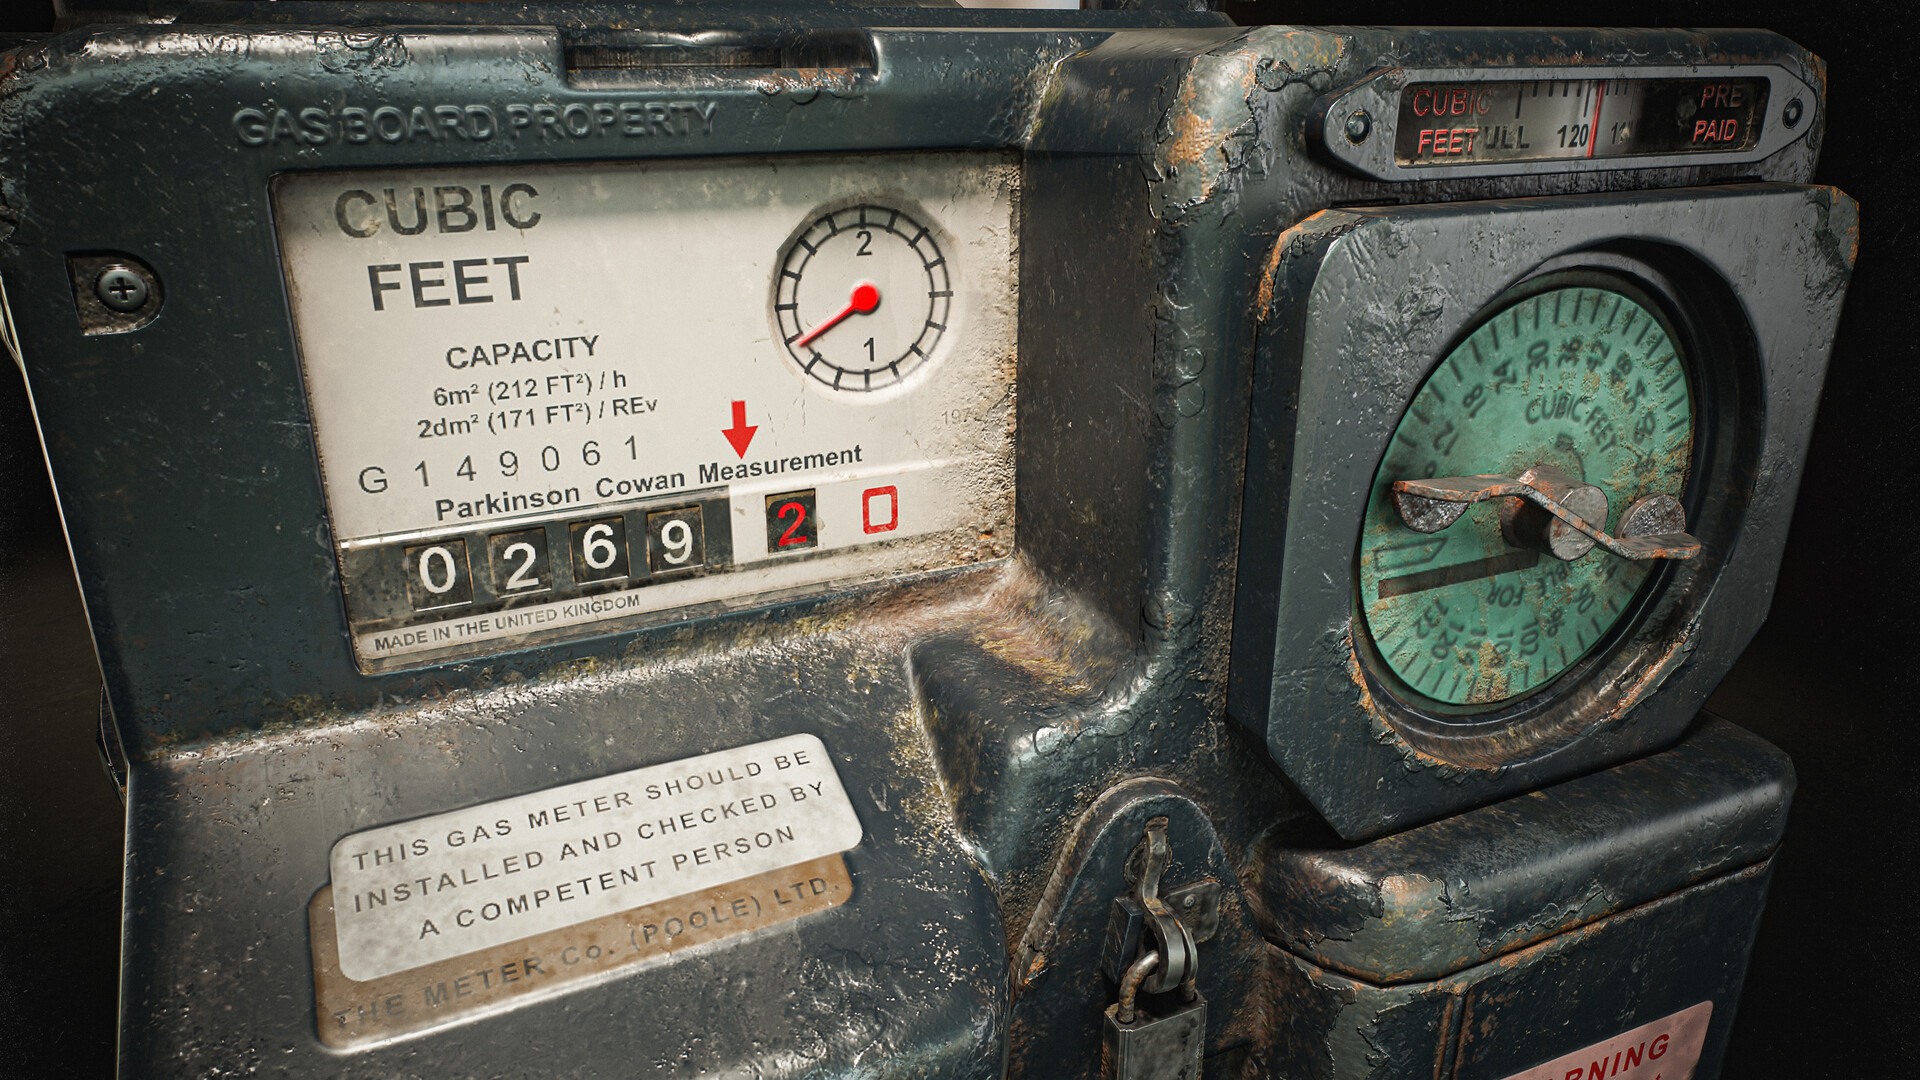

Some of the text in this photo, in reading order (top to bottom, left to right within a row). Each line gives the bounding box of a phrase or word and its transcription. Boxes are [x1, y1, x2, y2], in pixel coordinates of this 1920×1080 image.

[1413, 87, 1494, 116] CUBIC
[1700, 83, 1742, 109] PRE
[231, 100, 720, 148] GAS BOARD PROPERTY
[1417, 127, 1480, 155] FEET
[1474, 125, 1531, 150] ULL
[1556, 122, 1589, 149] 120
[1692, 118, 1738, 142] PAID
[333, 182, 543, 239] CUBIC
[855, 230, 873, 257] 2
[366, 255, 530, 312] FEET
[445, 334, 600, 370] CAPACITY
[862, 336, 876, 362] 1
[488, 379, 538, 406] (212
[612, 370, 627, 389] h
[1462, 383, 1488, 420] 18
[487, 407, 536, 436] (171
[1525, 392, 1618, 454] CUBIC FEET
[435, 444, 863, 522] Parkinson Cowan Measurement
[374, 593, 641, 652] MADE IN THE UNITED KINGDOM
[351, 750, 811, 871] THIS GAS METER SHOULD BE
[353, 780, 823, 913] INSTALLED AND CHECKED BY
[418, 825, 796, 940] A COMPETENT PERSON
[332, 876, 841, 1030] THE METER Co. (POOLE) LTD.
